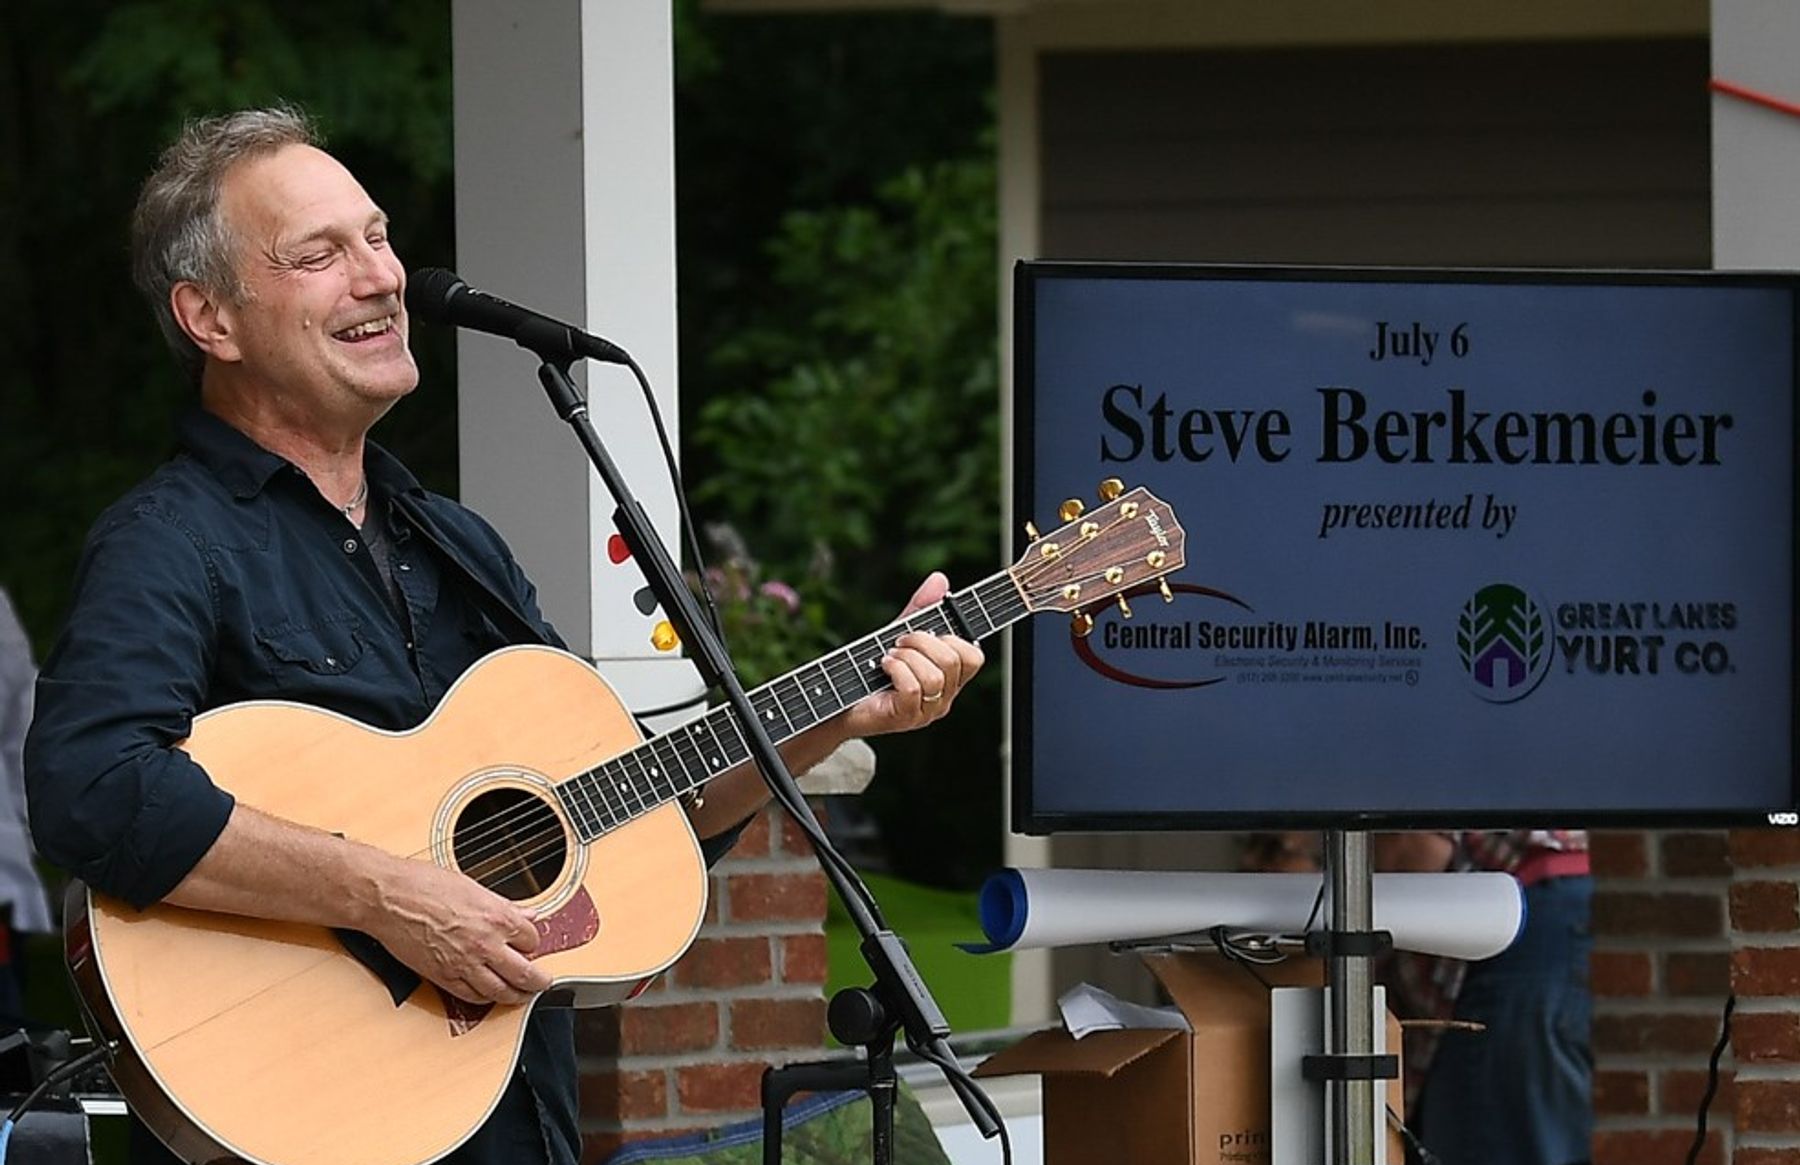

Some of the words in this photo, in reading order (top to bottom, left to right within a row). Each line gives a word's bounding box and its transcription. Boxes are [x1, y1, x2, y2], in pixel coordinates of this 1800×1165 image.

[1369, 321, 1439, 367] July
[1450, 321, 1469, 358] 6
[1101, 384, 1291, 464] Steve
[1316, 387, 1734, 466] Berkemeier
[1318, 493, 1474, 539] presented
[1482, 493, 1517, 539] by
[1104, 621, 1191, 649] Central
[1198, 621, 1298, 651] Security
[1303, 621, 1378, 651] Alarm,
[1384, 621, 1428, 650] Inc.
[1556, 602, 1647, 631] GREAT
[1268, 655, 1308, 669] Security
[1378, 655, 1421, 667] Services
[1556, 635, 1665, 676] YURT
[1674, 641, 1737, 676] CO.
